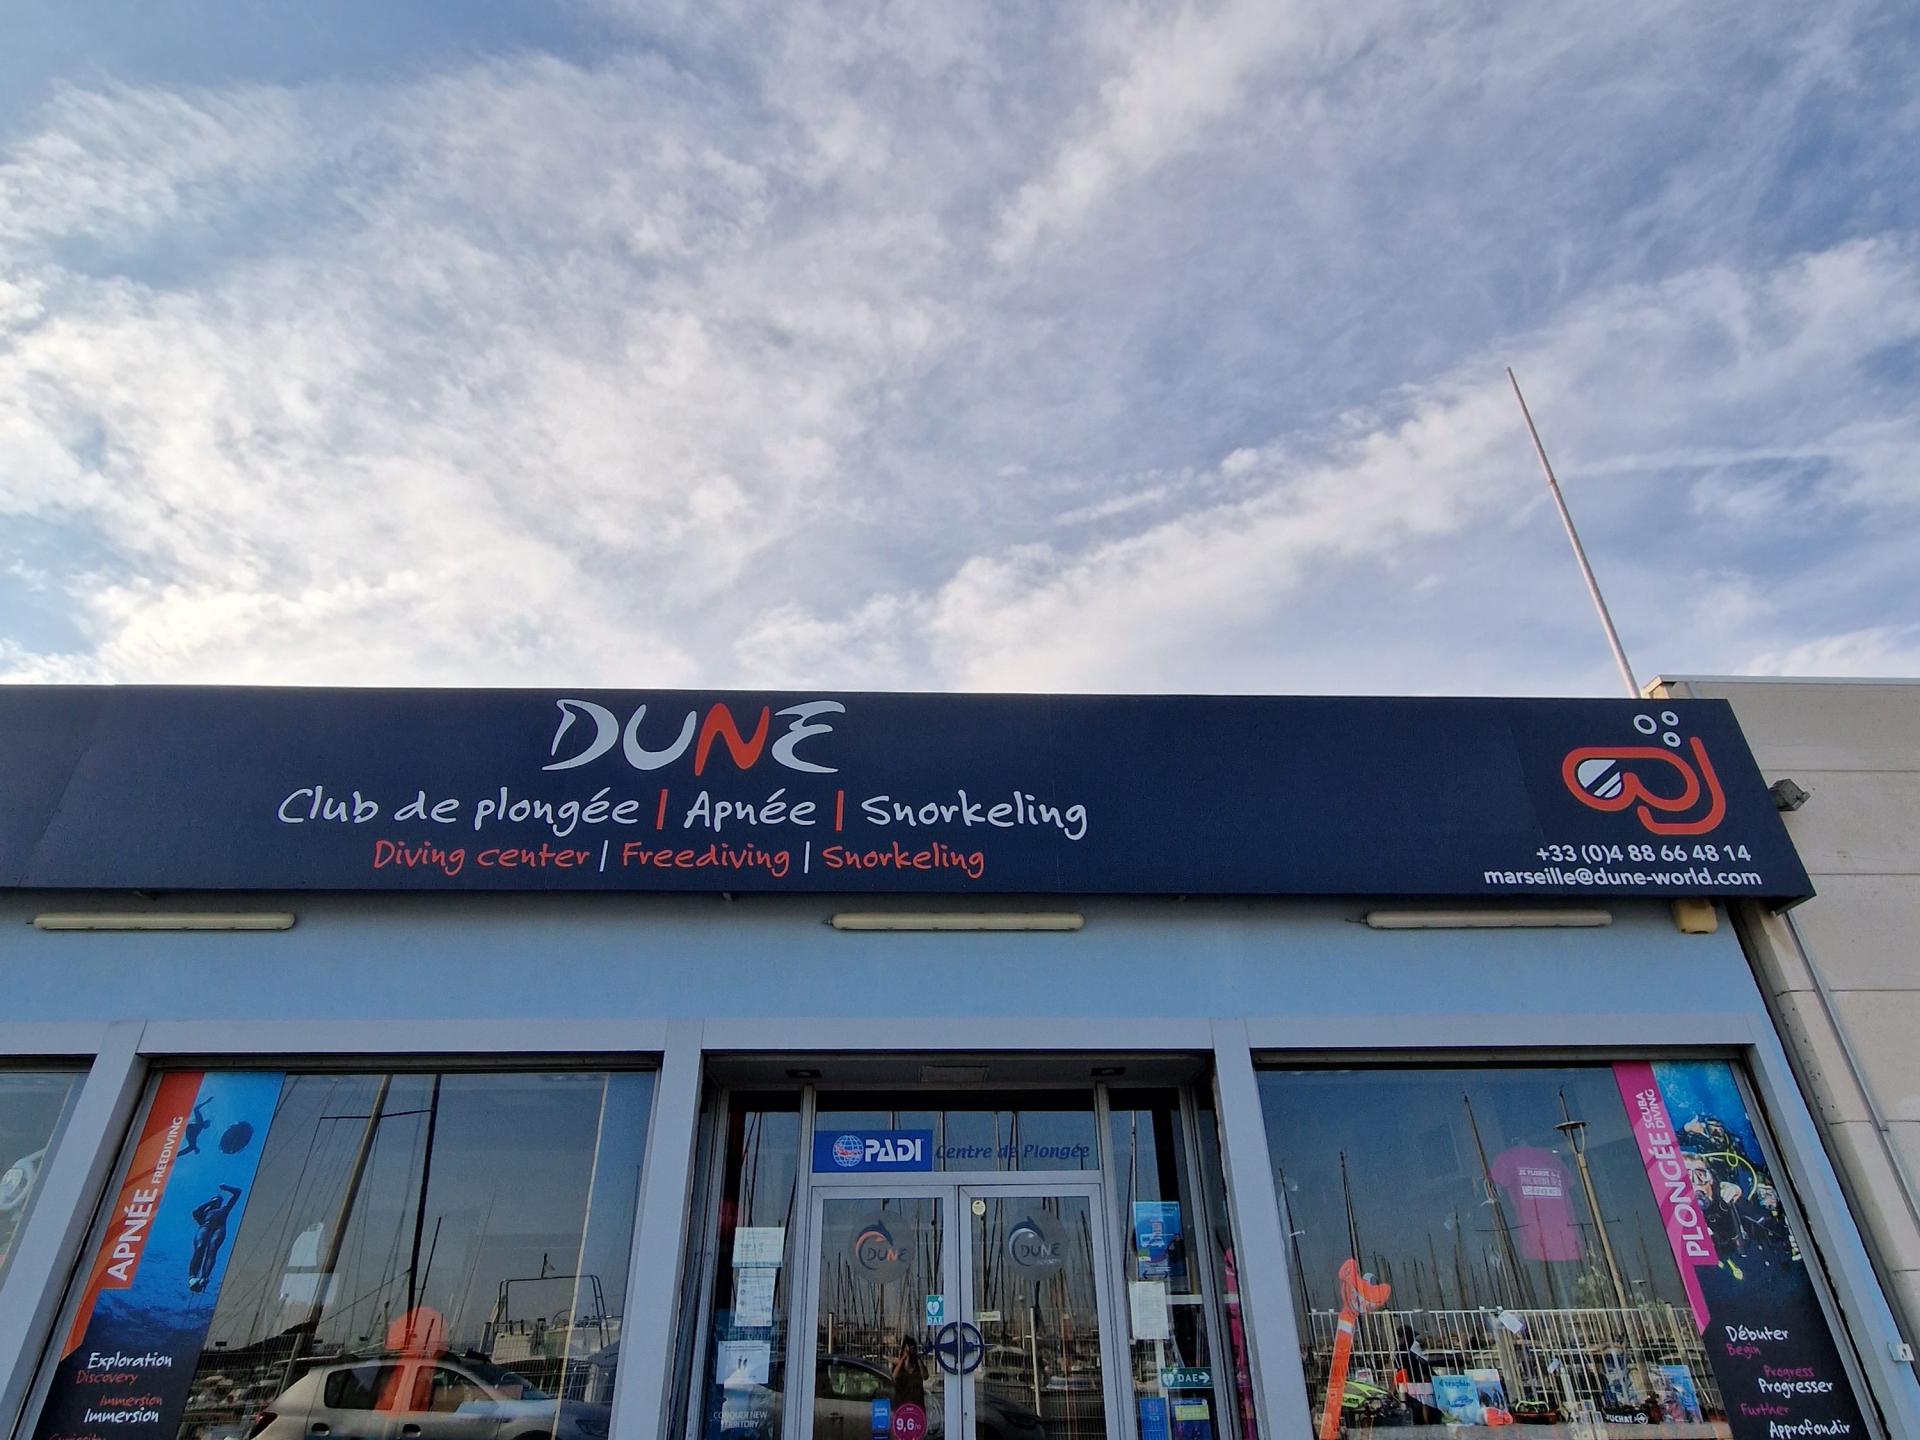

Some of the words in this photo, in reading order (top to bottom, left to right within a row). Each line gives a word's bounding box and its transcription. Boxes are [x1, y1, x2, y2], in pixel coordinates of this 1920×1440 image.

[542, 699, 846, 776] DUNE
[278, 785, 379, 824] Club
[394, 791, 461, 823] de
[474, 786, 639, 837] plongée
[683, 787, 816, 832] Apnée
[861, 789, 1088, 841] Snorkeling
[372, 839, 465, 877] Diving
[475, 842, 591, 868] center
[622, 841, 789, 878] Freediving
[821, 840, 984, 879] Snorkeling
[1536, 845, 1576, 862] +33
[1581, 844, 1623, 864] (0)4
[1628, 845, 1656, 862] 88
[1660, 845, 1687, 862] 66
[1692, 845, 1720, 862] 48
[1724, 845, 1751, 862] 14
[1483, 868, 1763, 886] marseille@dune-world.com
[1636, 1091, 1655, 1129] SCUBA
[1645, 1088, 1665, 1129] DIVING
[865, 1138, 922, 1162] PADI
[935, 1144, 992, 1159] Centre
[997, 1144, 1018, 1159] de
[1023, 1143, 1090, 1160] Plongée
[107, 1188, 158, 1281] APNÉE
[152, 1116, 183, 1184] FREEDIVING
[1649, 1132, 1710, 1257] PLONGÉE
[866, 1247, 908, 1262] DUNE
[1020, 1242, 1061, 1258] DUNE
[1725, 1324, 1789, 1343] Débuter
[1726, 1343, 1761, 1359] Begin
[87, 1352, 172, 1371] Exploration
[76, 1370, 139, 1386] Discovery
[1177, 1374, 1199, 1382] DAE
[1763, 1365, 1815, 1382] Progress
[1758, 1378, 1833, 1399] Progresser
[99, 1394, 163, 1407] Immersion
[1740, 1403, 1789, 1416] Further
[84, 1407, 159, 1424] Immersion
[751, 1410, 768, 1420] NEW
[1769, 1418, 1850, 1440] Approfondir
